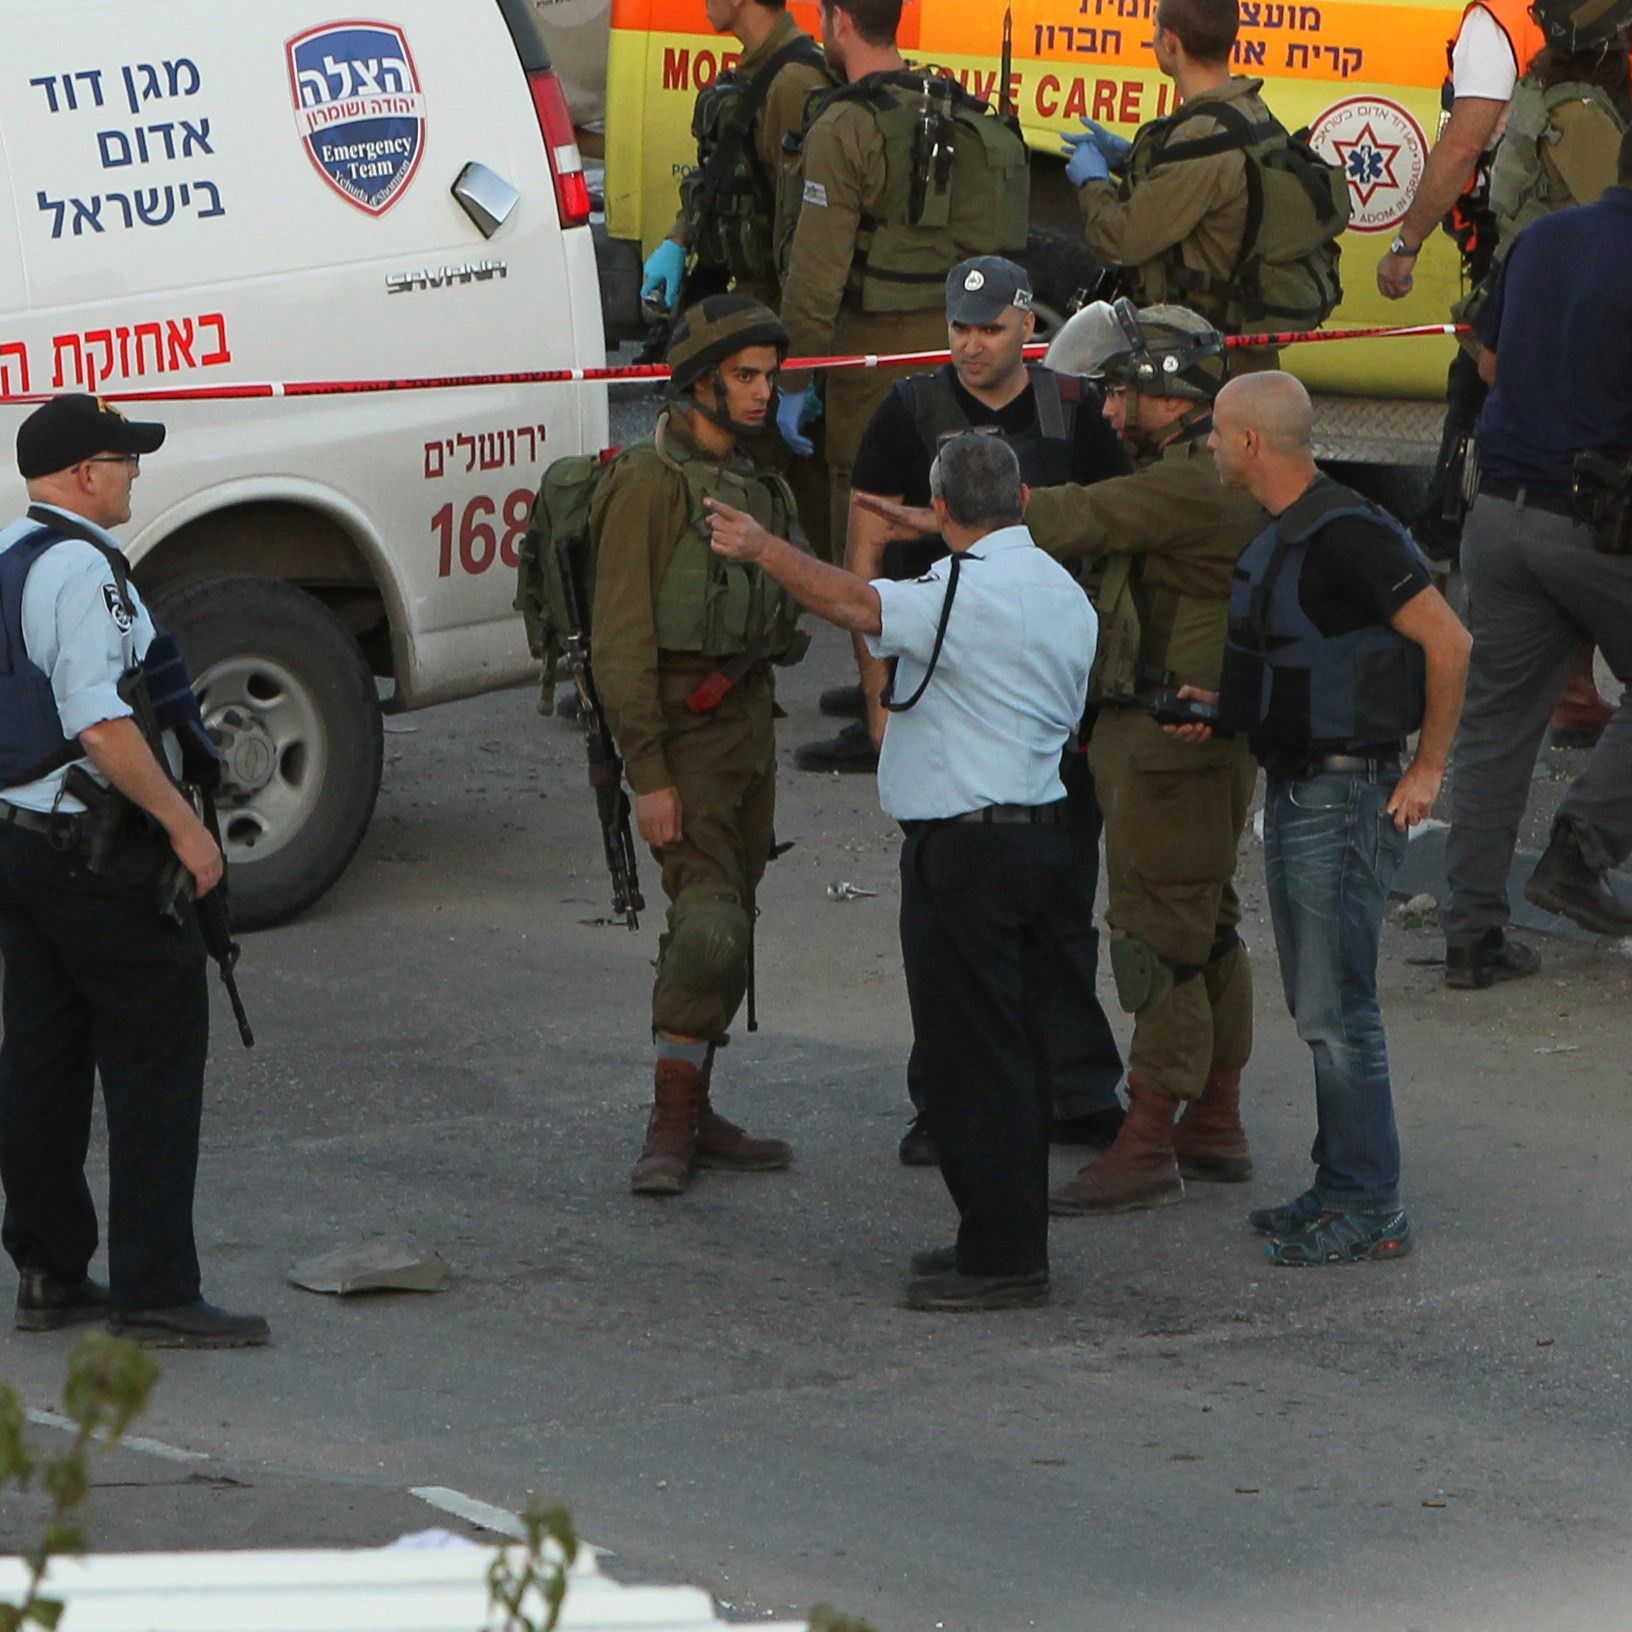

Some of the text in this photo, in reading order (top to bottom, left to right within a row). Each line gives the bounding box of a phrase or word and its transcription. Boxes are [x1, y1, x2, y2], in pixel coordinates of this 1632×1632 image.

[1239, 0, 1322, 32] מועצ
[1035, 24, 1123, 56] חברון
[1285, 42, 1364, 78] קרית
[29, 57, 201, 114] מגן דוד
[298, 54, 412, 107] הצלה
[306, 97, 415, 132] יהודה ושומרון
[1035, 74, 1145, 124] CARE
[96, 120, 213, 169] אדום
[322, 137, 412, 163] Emergency
[347, 160, 393, 180] Team
[36, 179, 226, 240] בישראל
[1359, 207, 1396, 225] ADOM
[385, 260, 507, 295] SAVANA
[52, 312, 231, 392] באחזקת
[424, 423, 547, 480] ירושלים
